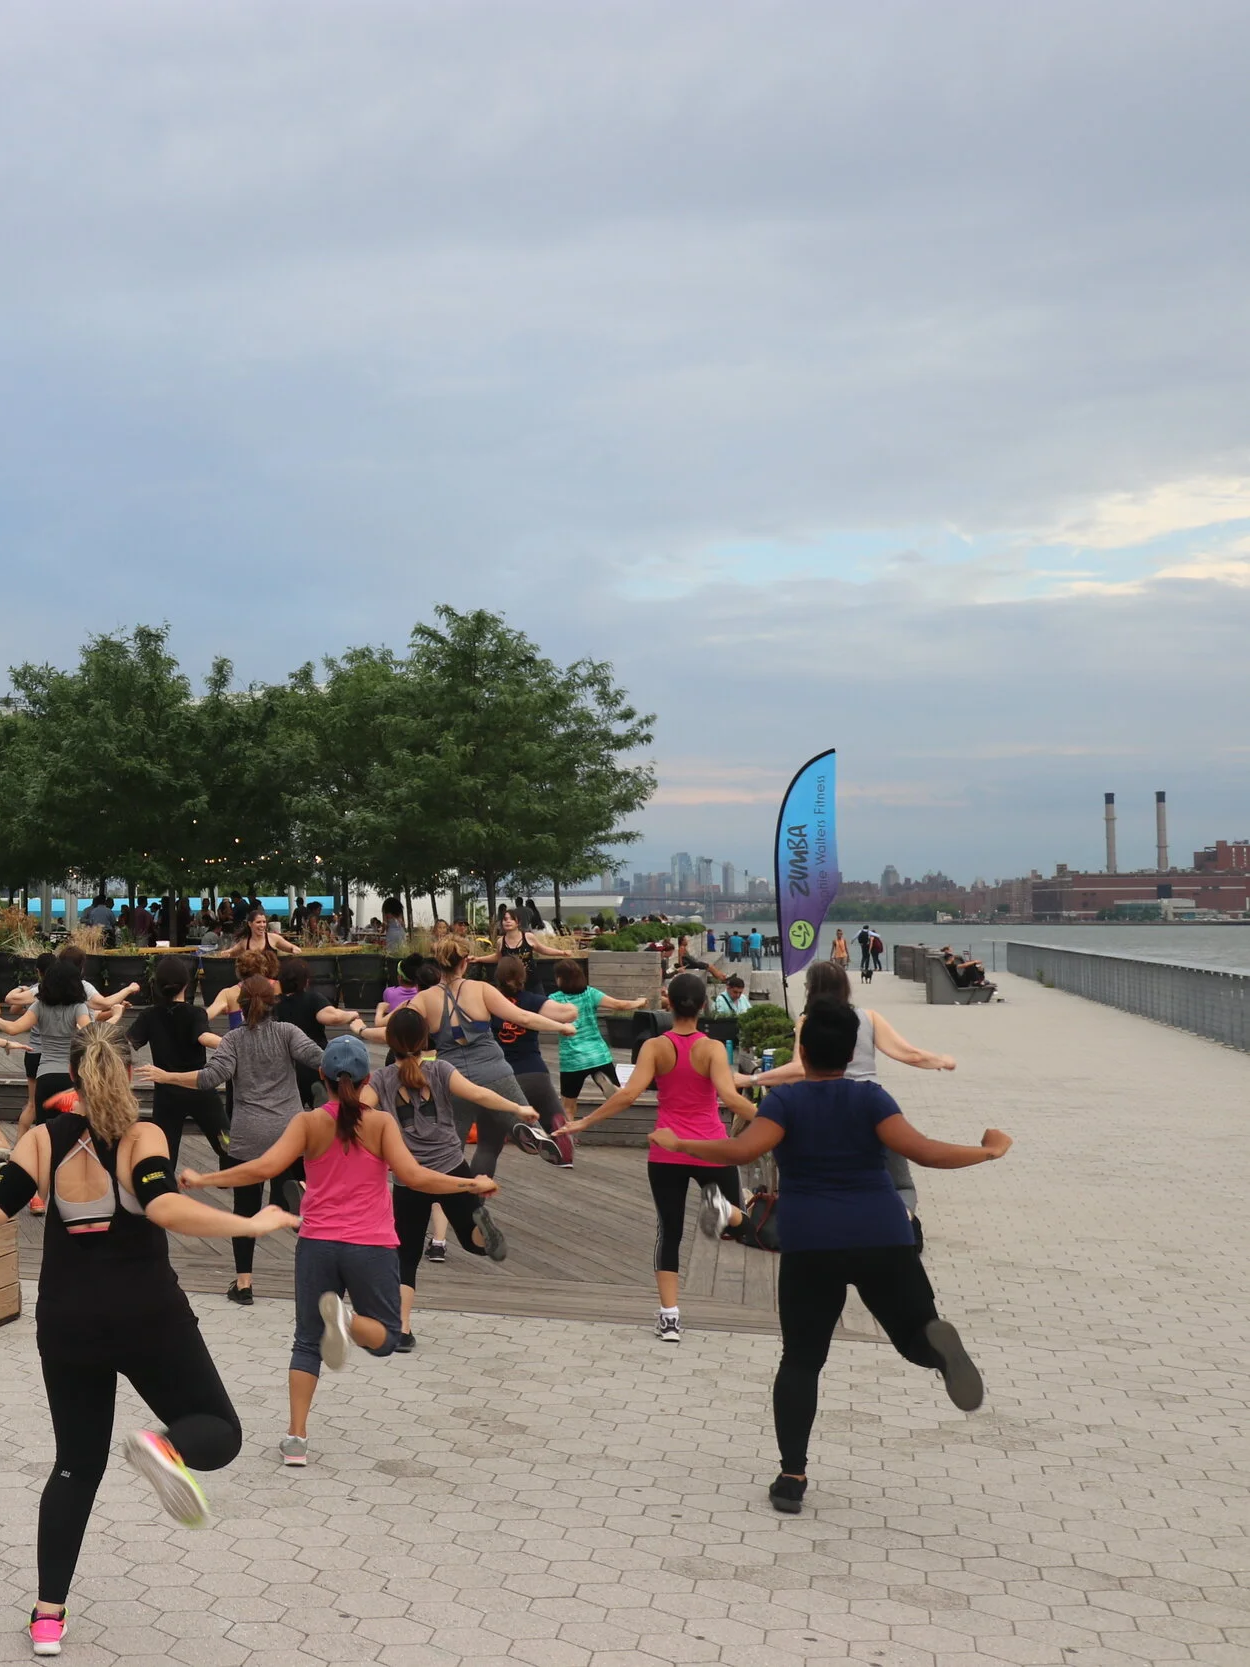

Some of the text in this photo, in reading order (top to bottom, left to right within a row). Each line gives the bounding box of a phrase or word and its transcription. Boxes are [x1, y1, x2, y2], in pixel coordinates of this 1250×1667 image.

[813, 775, 826, 815] Fitness
[787, 823, 811, 899] ZUMBA
[814, 820, 827, 866] Walters
